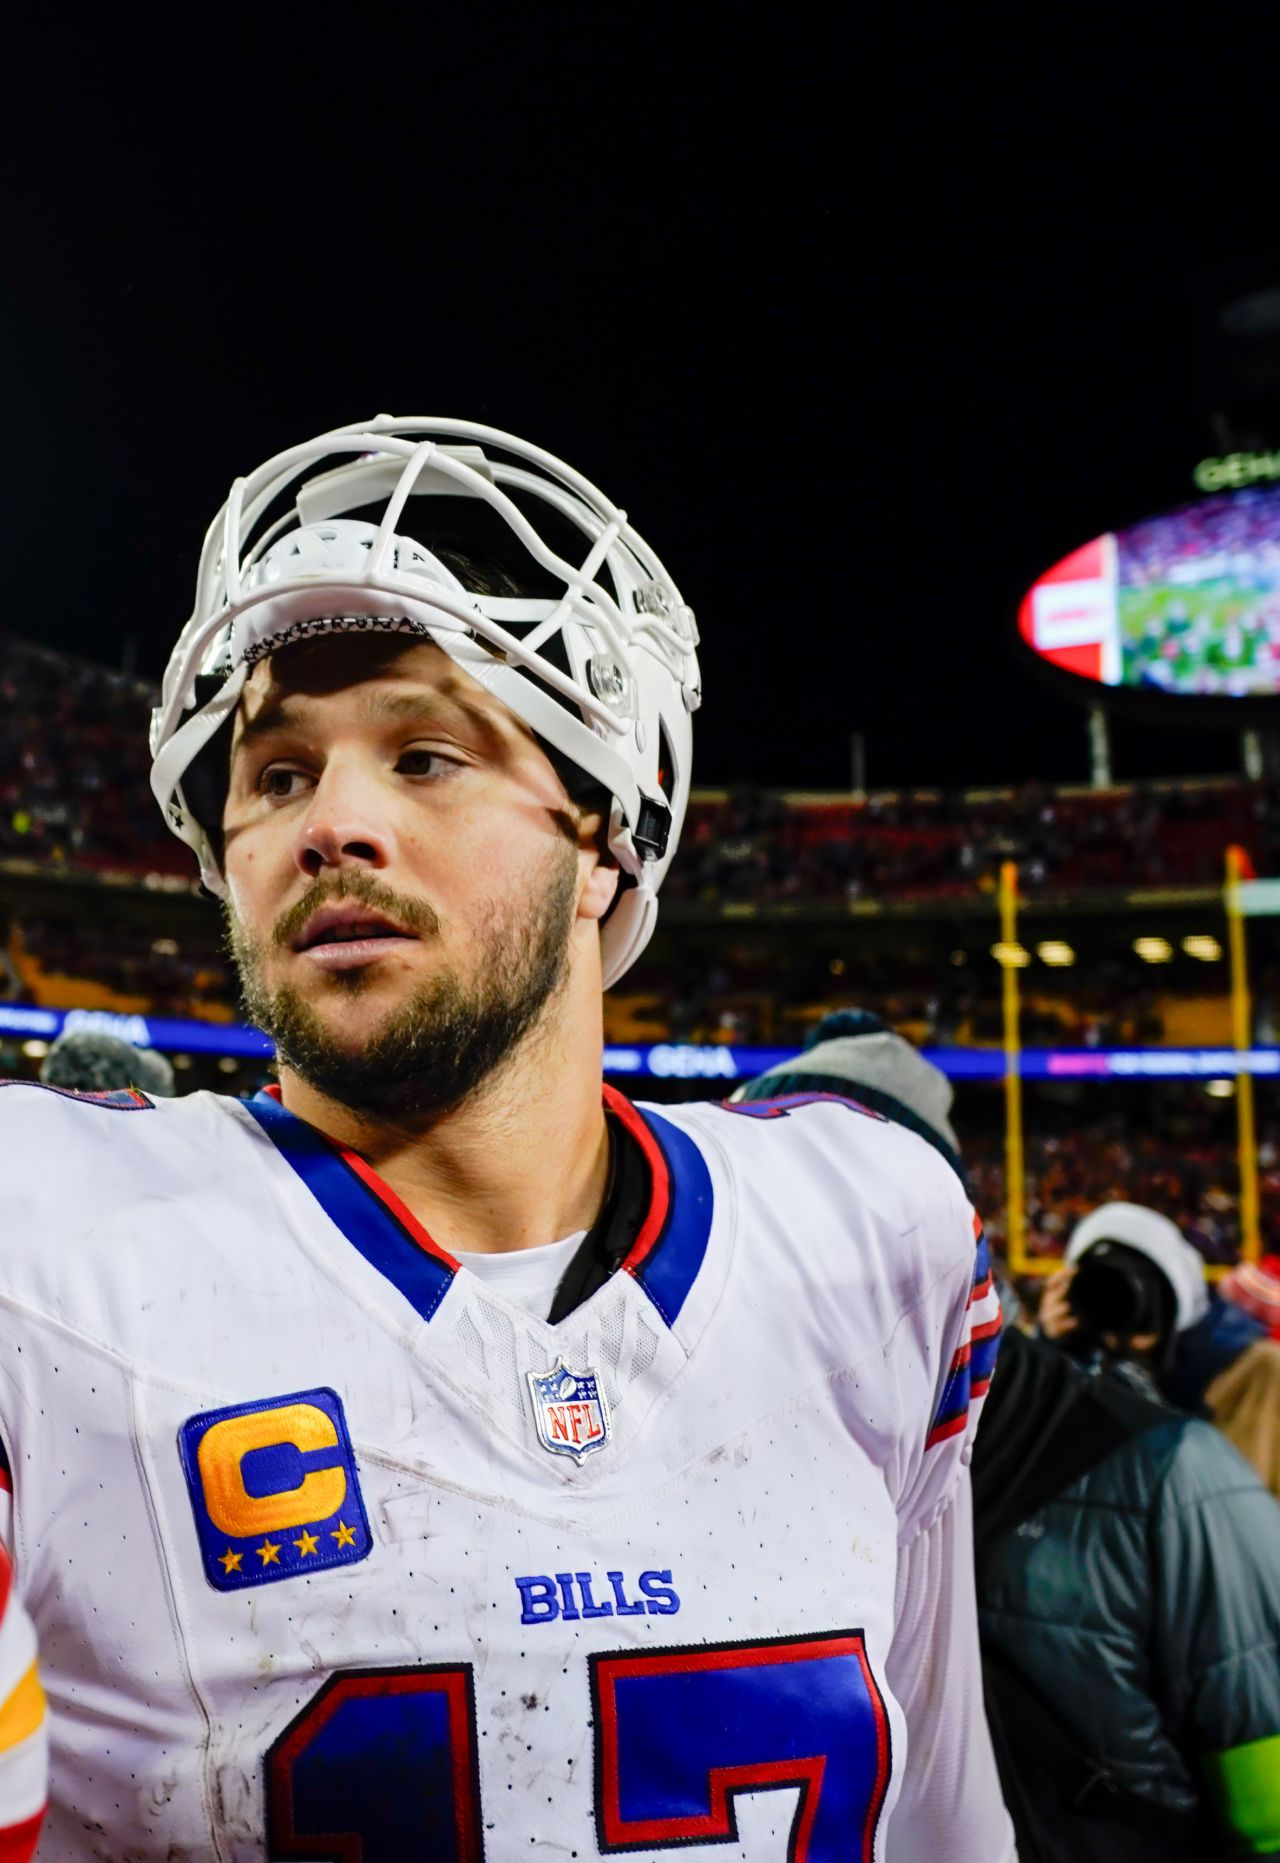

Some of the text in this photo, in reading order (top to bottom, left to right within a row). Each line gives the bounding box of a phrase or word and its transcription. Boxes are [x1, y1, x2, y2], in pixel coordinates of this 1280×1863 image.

[1193, 452, 1280, 492] GEH
[648, 1044, 737, 1078] GEHA
[548, 1400, 602, 1444] NFL
[197, 1402, 347, 1538] C
[515, 1569, 681, 1625] BILLS
[262, 1628, 892, 1863] 17
